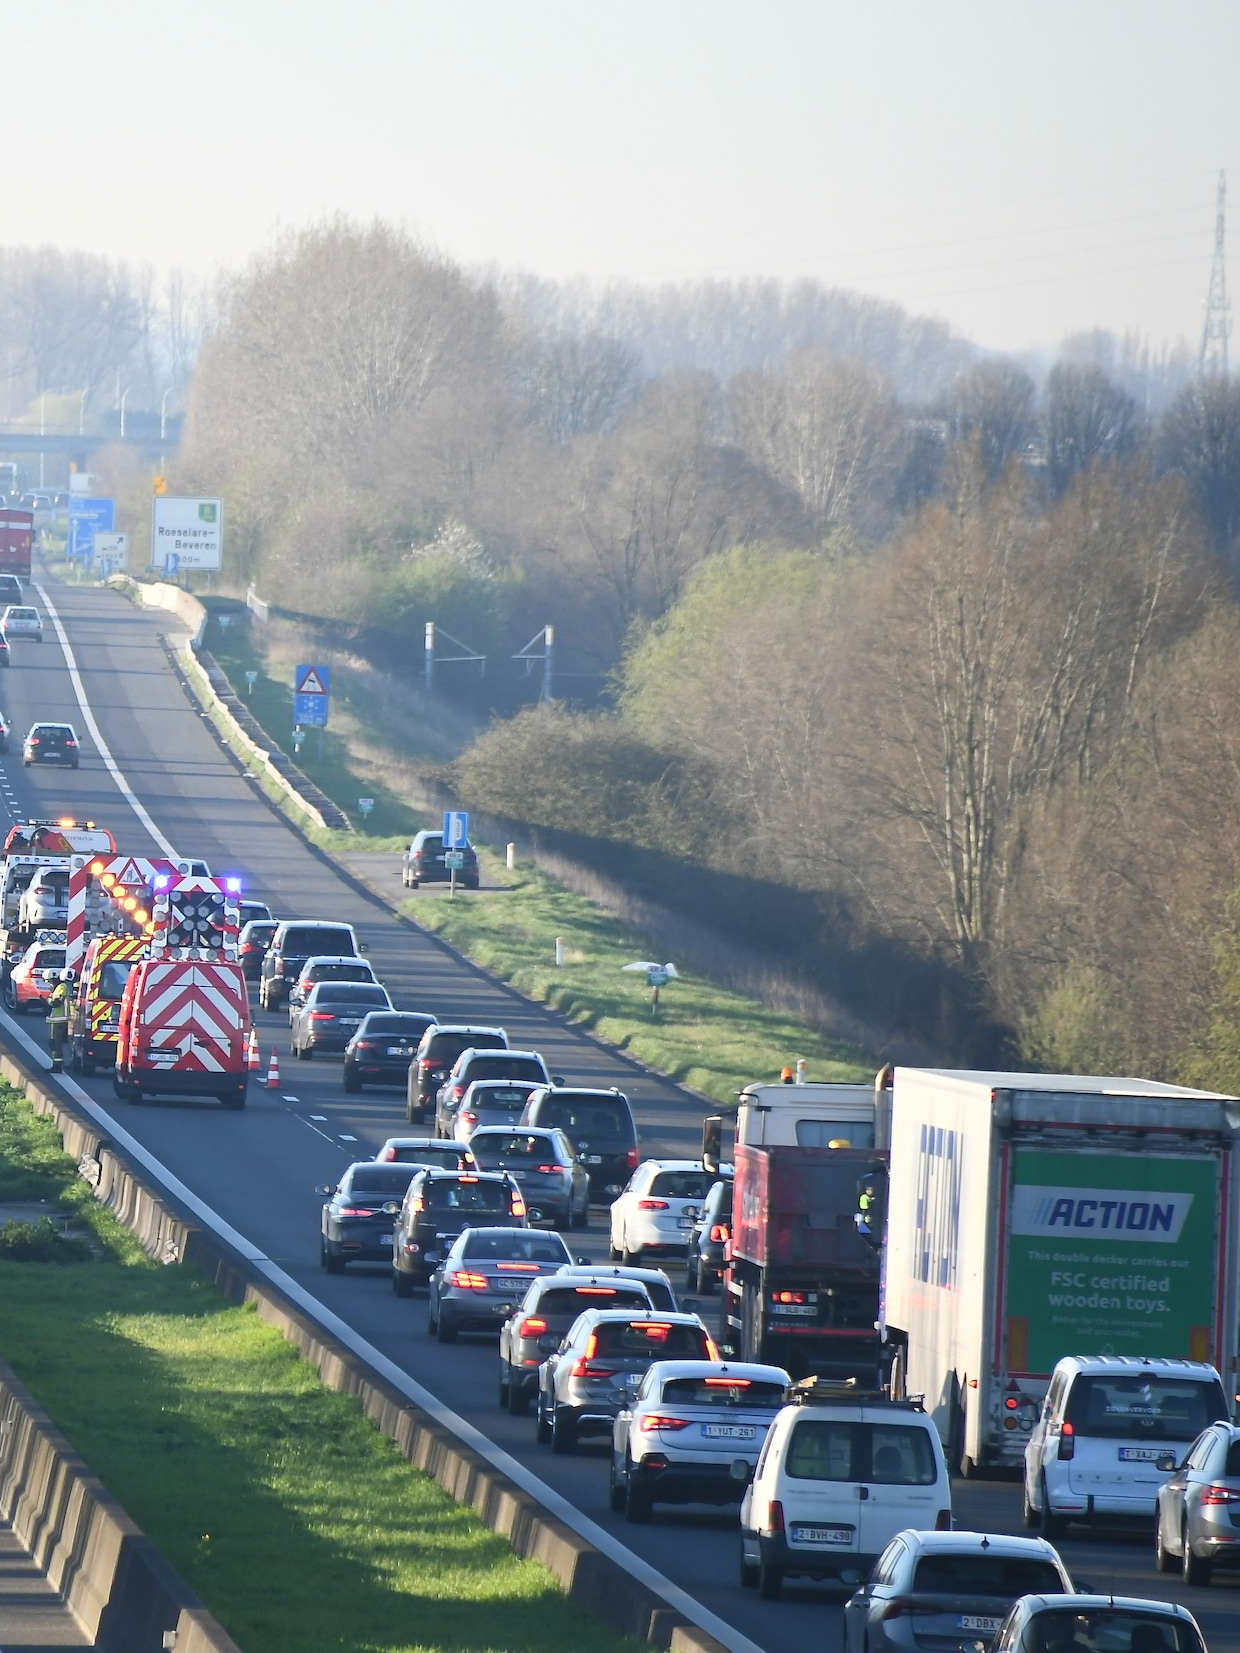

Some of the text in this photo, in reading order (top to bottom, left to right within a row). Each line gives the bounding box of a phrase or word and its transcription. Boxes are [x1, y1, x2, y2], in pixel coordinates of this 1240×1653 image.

[158, 527, 215, 537] Roeselare-
[175, 540, 216, 550] Beveren
[298, 714, 313, 723] 300
[1048, 1198, 1175, 1232] ACTION
[1027, 1251, 1190, 1268] This double decker carries our
[1051, 1272, 1170, 1292] FSC certified
[1048, 1292, 1171, 1314] wooden toys.
[707, 1426, 754, 1437] 1-YUT-261
[798, 1529, 850, 1541] 2-BVH-498
